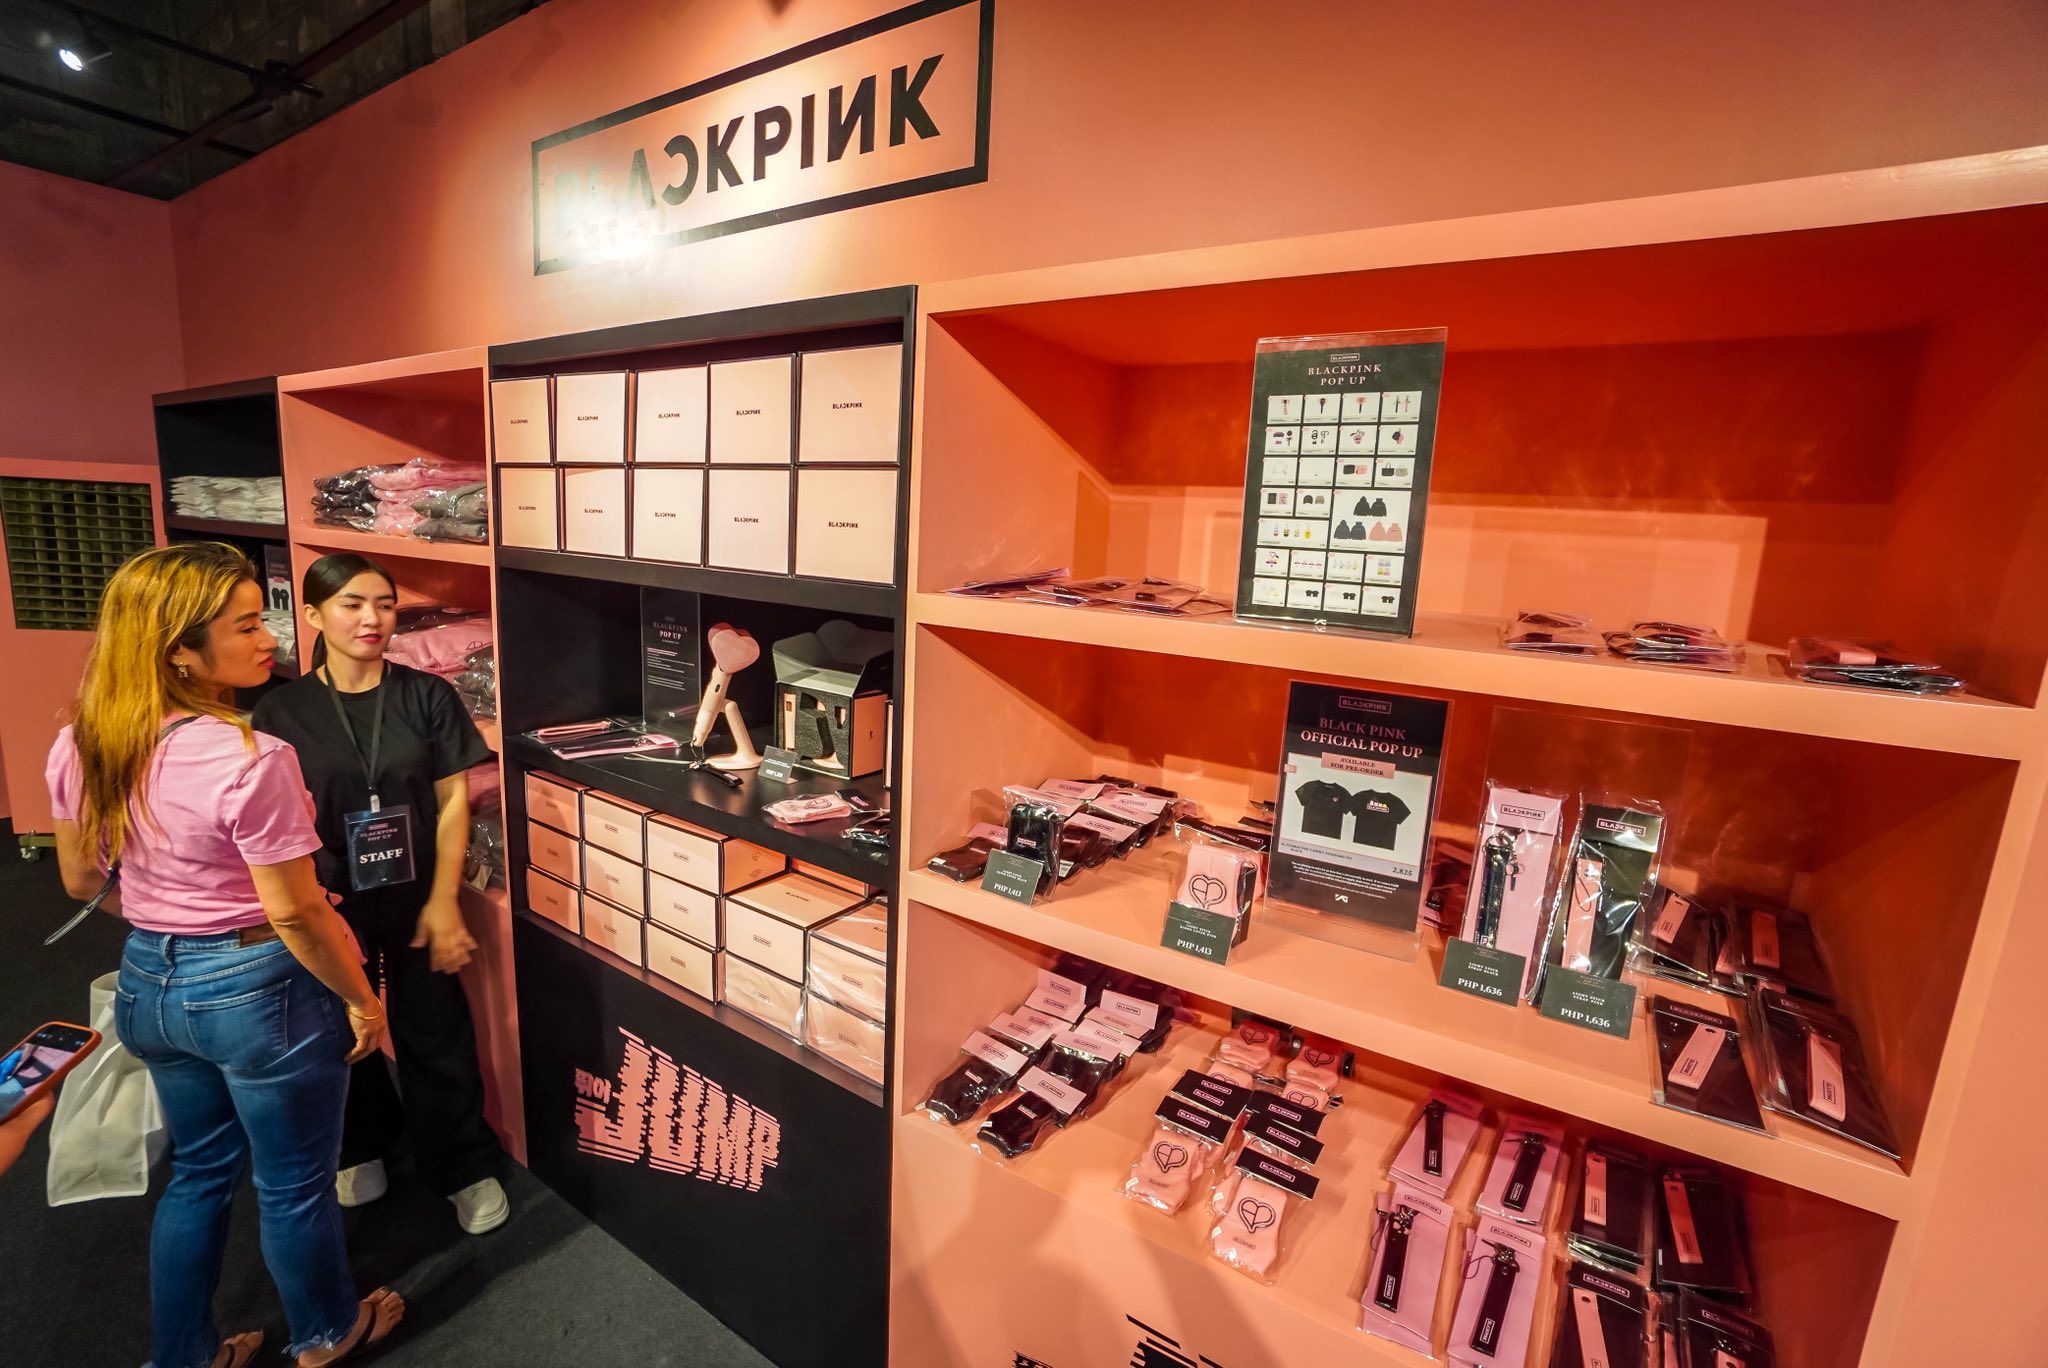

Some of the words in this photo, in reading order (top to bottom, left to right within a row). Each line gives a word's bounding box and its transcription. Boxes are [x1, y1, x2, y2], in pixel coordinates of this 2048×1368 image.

[1308, 364, 1382, 376] BLACKPINK
[1321, 377, 1344, 386] POP
[1349, 376, 1366, 385] UP
[660, 630, 672, 638] POP
[673, 632, 682, 640] UP
[1342, 699, 1388, 711] BLACKPINK
[1319, 717, 1365, 734] BLACK
[1370, 725, 1406, 740] PINK
[1301, 730, 1367, 750] OFFICIAL
[1369, 740, 1399, 755] POP
[1402, 745, 1423, 759] UP
[1341, 757, 1376, 767] AVAILABLE
[1345, 764, 1384, 776] PRE-ORDER
[1502, 806, 1543, 818] BLACKPINK
[360, 848, 403, 864] STAFF
[994, 883, 1008, 893] PHP
[1177, 939, 1195, 950] PHP
[1195, 944, 1213, 956] 1,413
[1457, 977, 1479, 989] PHP
[1479, 984, 1503, 997] 1,636
[1560, 1008, 1584, 1020] PHP
[1585, 1014, 1611, 1028] 1,636
[1585, 1275, 1627, 1294] BLACKPINK
